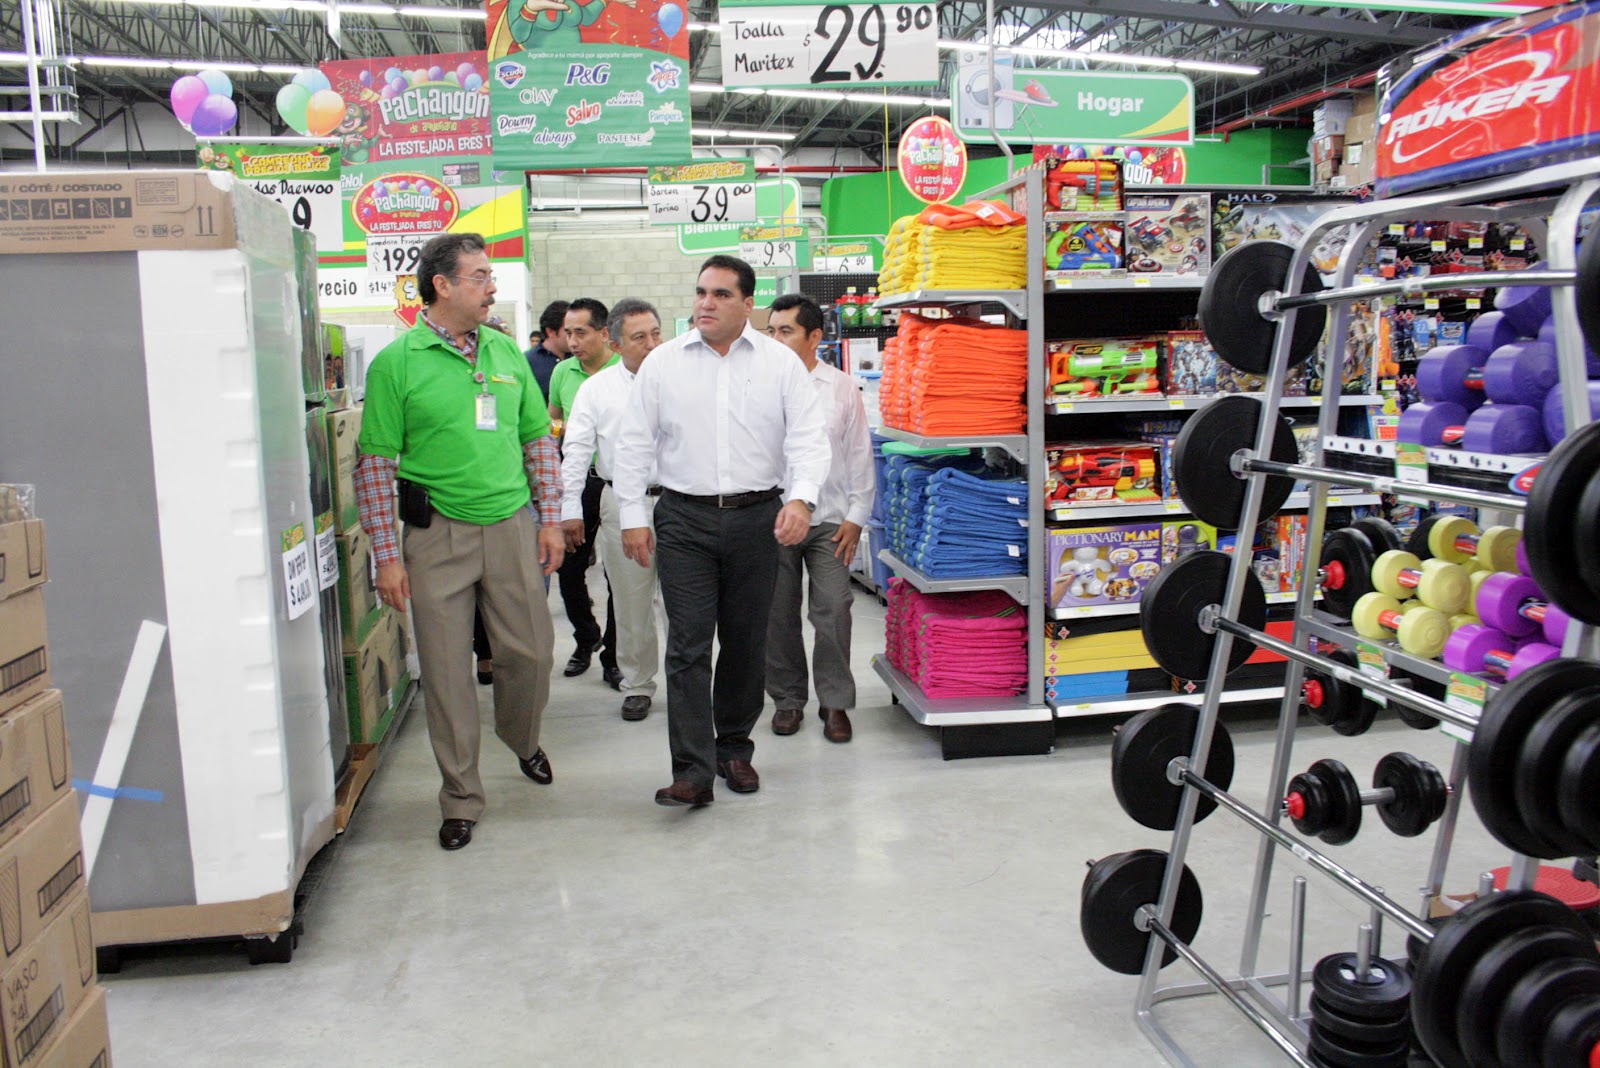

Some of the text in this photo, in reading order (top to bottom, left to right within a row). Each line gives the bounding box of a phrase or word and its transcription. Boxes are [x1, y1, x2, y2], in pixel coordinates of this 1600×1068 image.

[729, 20, 786, 41] Toalla
[734, 54, 796, 74] Maritex
[566, 63, 610, 85] P&G
[653, 71, 677, 82] ARIEL
[1077, 91, 1144, 117] Hogar
[568, 101, 600, 125] Salvo
[650, 111, 681, 124] Pampers
[500, 115, 535, 131] Downy
[534, 129, 575, 146] always
[599, 134, 642, 143] PANTENE
[379, 142, 394, 156] LA
[395, 138, 455, 155] FESTEJADA
[458, 136, 483, 151] ERES
[62, 183, 123, 193] COSTADO
[280, 180, 333, 194] Daewoo
[1227, 193, 1278, 203] HALO
[652, 203, 680, 214] Torino
[370, 223, 379, 231] LA
[379, 221, 415, 231] FESTEJADA
[319, 279, 358, 296] recio
[1055, 529, 1160, 546] PICTIONARY MAN
